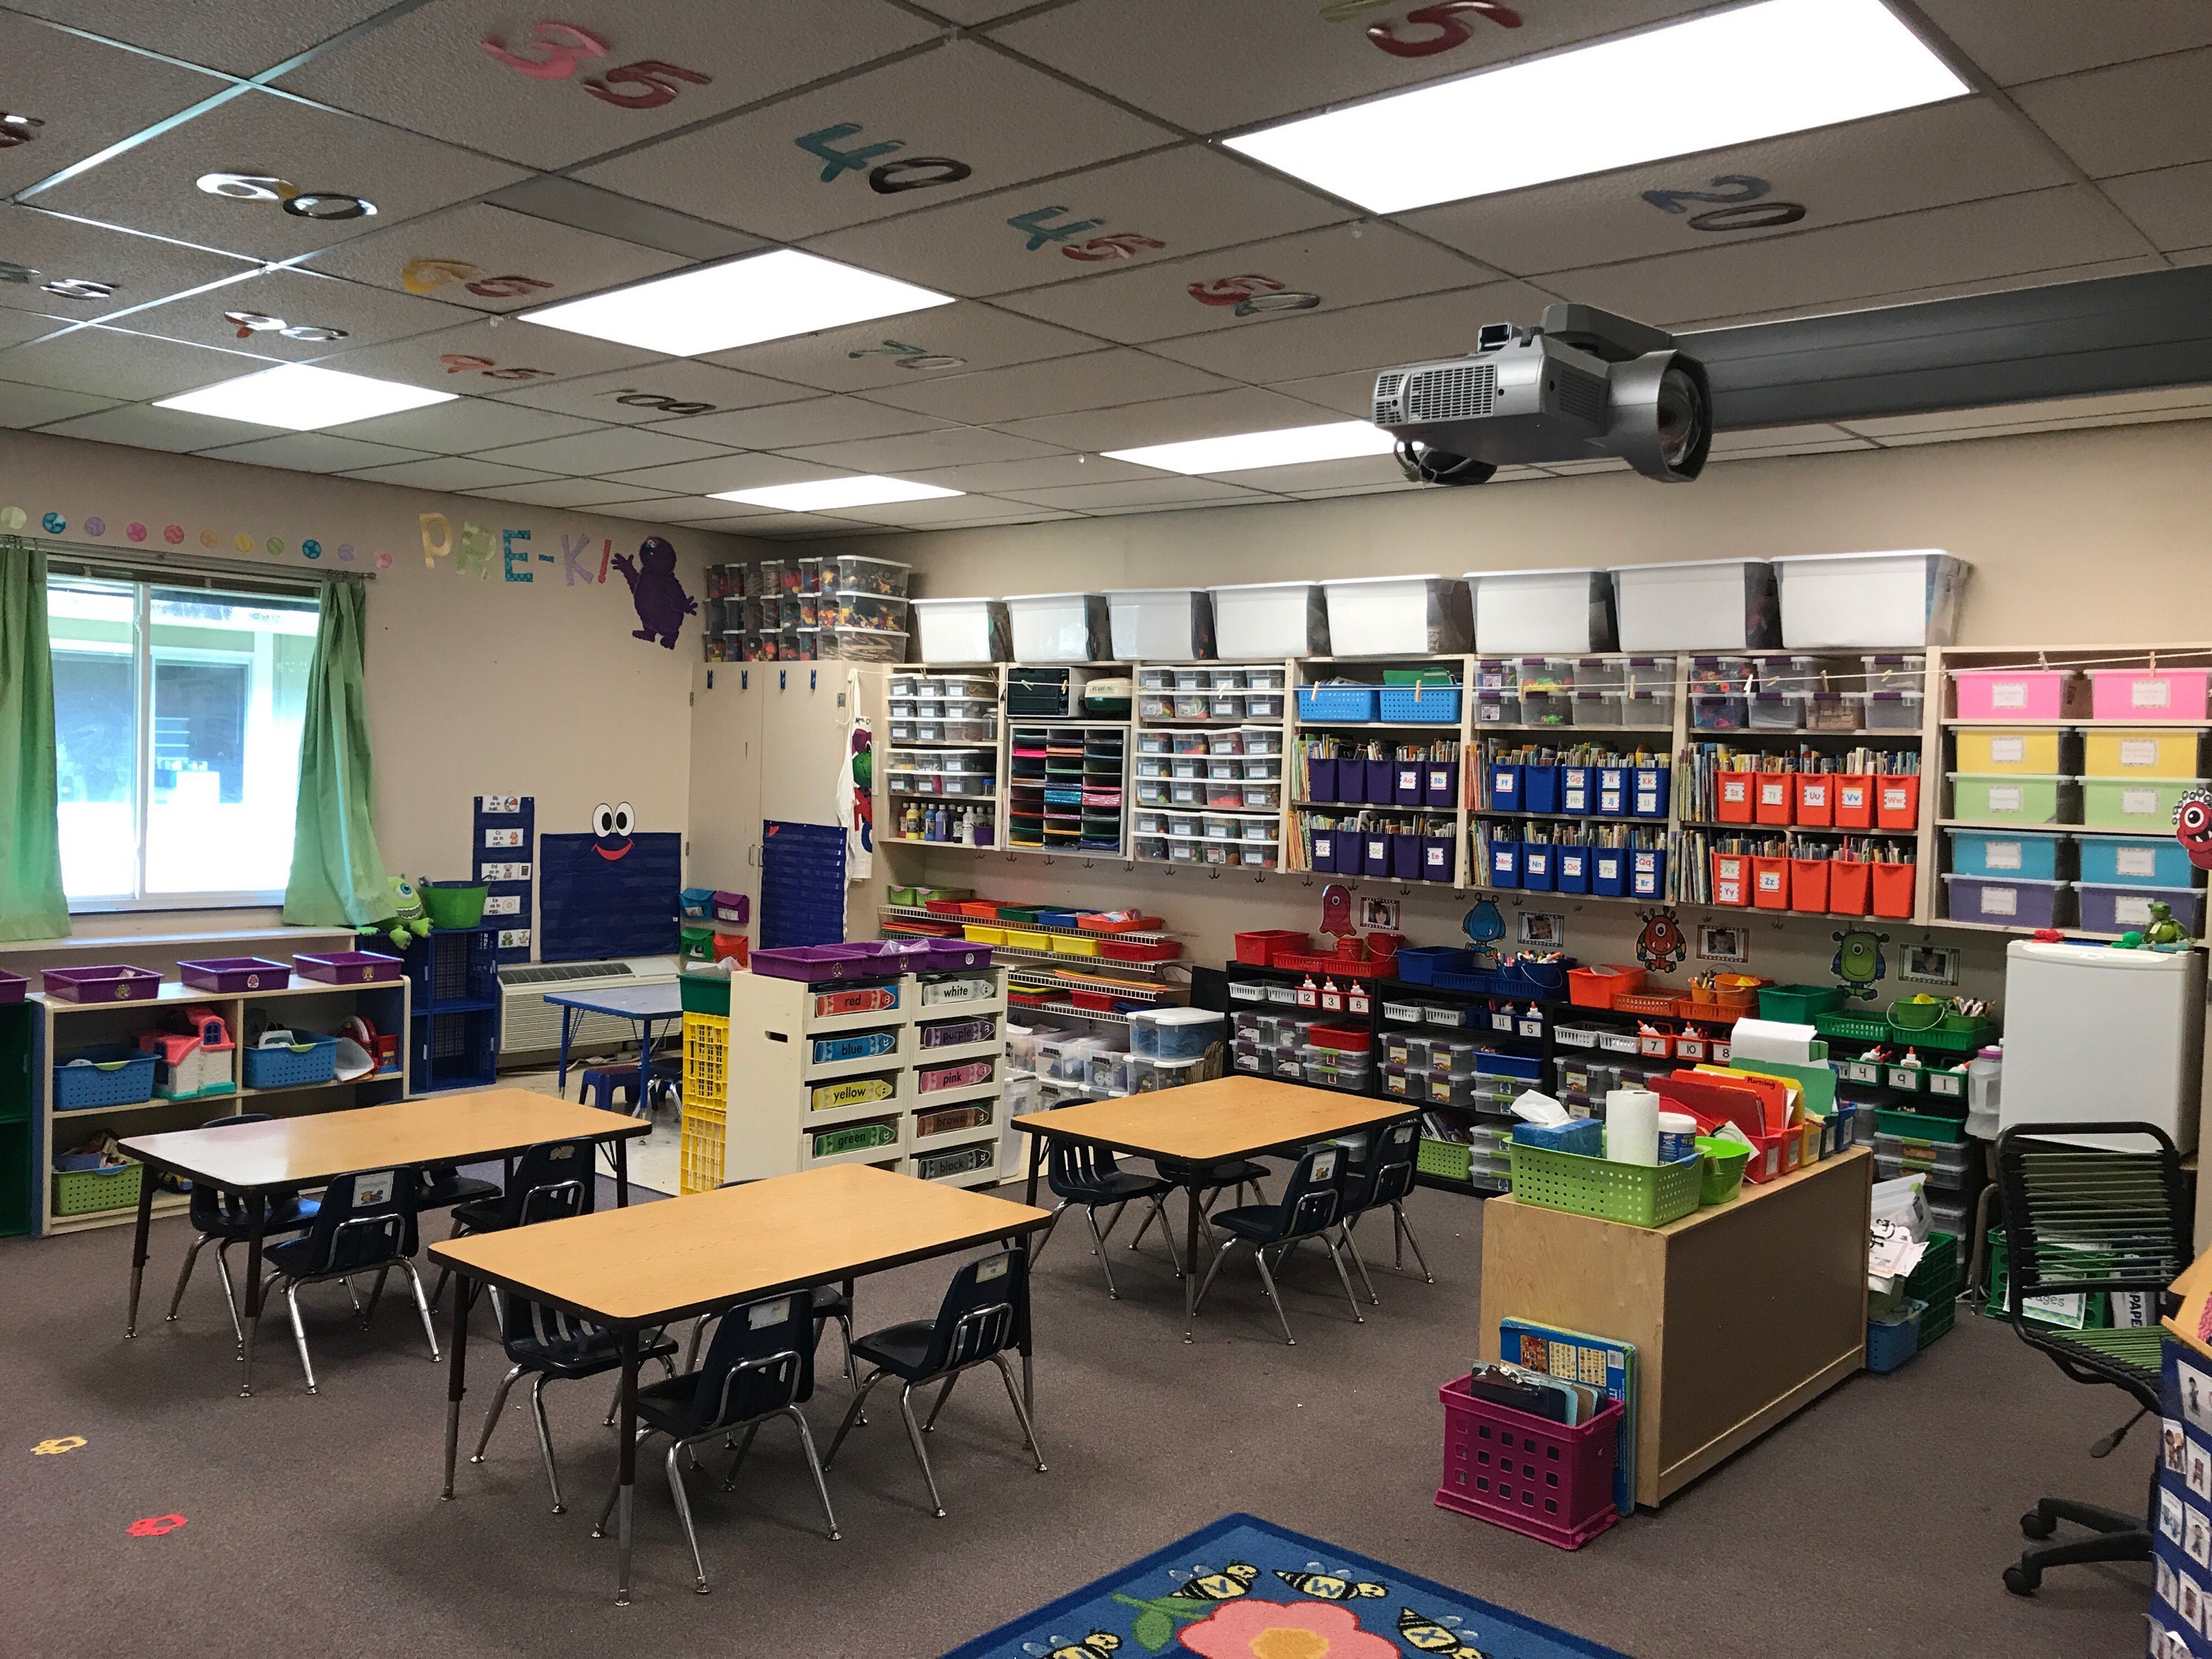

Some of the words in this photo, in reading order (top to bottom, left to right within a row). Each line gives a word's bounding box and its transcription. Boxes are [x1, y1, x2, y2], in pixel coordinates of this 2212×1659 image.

[481, 19, 712, 109] 35
[795, 122, 971, 194] 40
[1642, 175, 1806, 232] 20
[1006, 205, 1166, 262] 45
[1187, 274, 1320, 317] 50
[419, 512, 612, 586] PRE-K!
[944, 985, 968, 998] white
[1303, 993, 1311, 1002] 12
[844, 995, 861, 1006] red
[1328, 998, 1334, 1006] 3
[1356, 1000, 1362, 1009] 6
[1498, 1018, 1506, 1026] 11
[1526, 1023, 1534, 1034] 5
[942, 1026, 972, 1043] purple
[841, 1043, 863, 1056] blue
[1651, 1041, 1657, 1051] 7
[1687, 1045, 1697, 1054] 10
[1722, 1048, 1730, 1058] 8
[1859, 1067, 1867, 1077] 4
[943, 1072, 962, 1086] pink
[1747, 1077, 1775, 1090] Morning
[1897, 1073, 1905, 1085] 9
[833, 1086, 866, 1103] yellow
[936, 1114, 965, 1127] brown
[838, 1132, 866, 1147] green
[939, 1158, 964, 1172] black
[2129, 1294, 2143, 1327] PAPE
[1204, 1579, 1228, 1593] V
[1312, 1578, 1340, 1597] W
[1410, 1630, 1440, 1645] X
